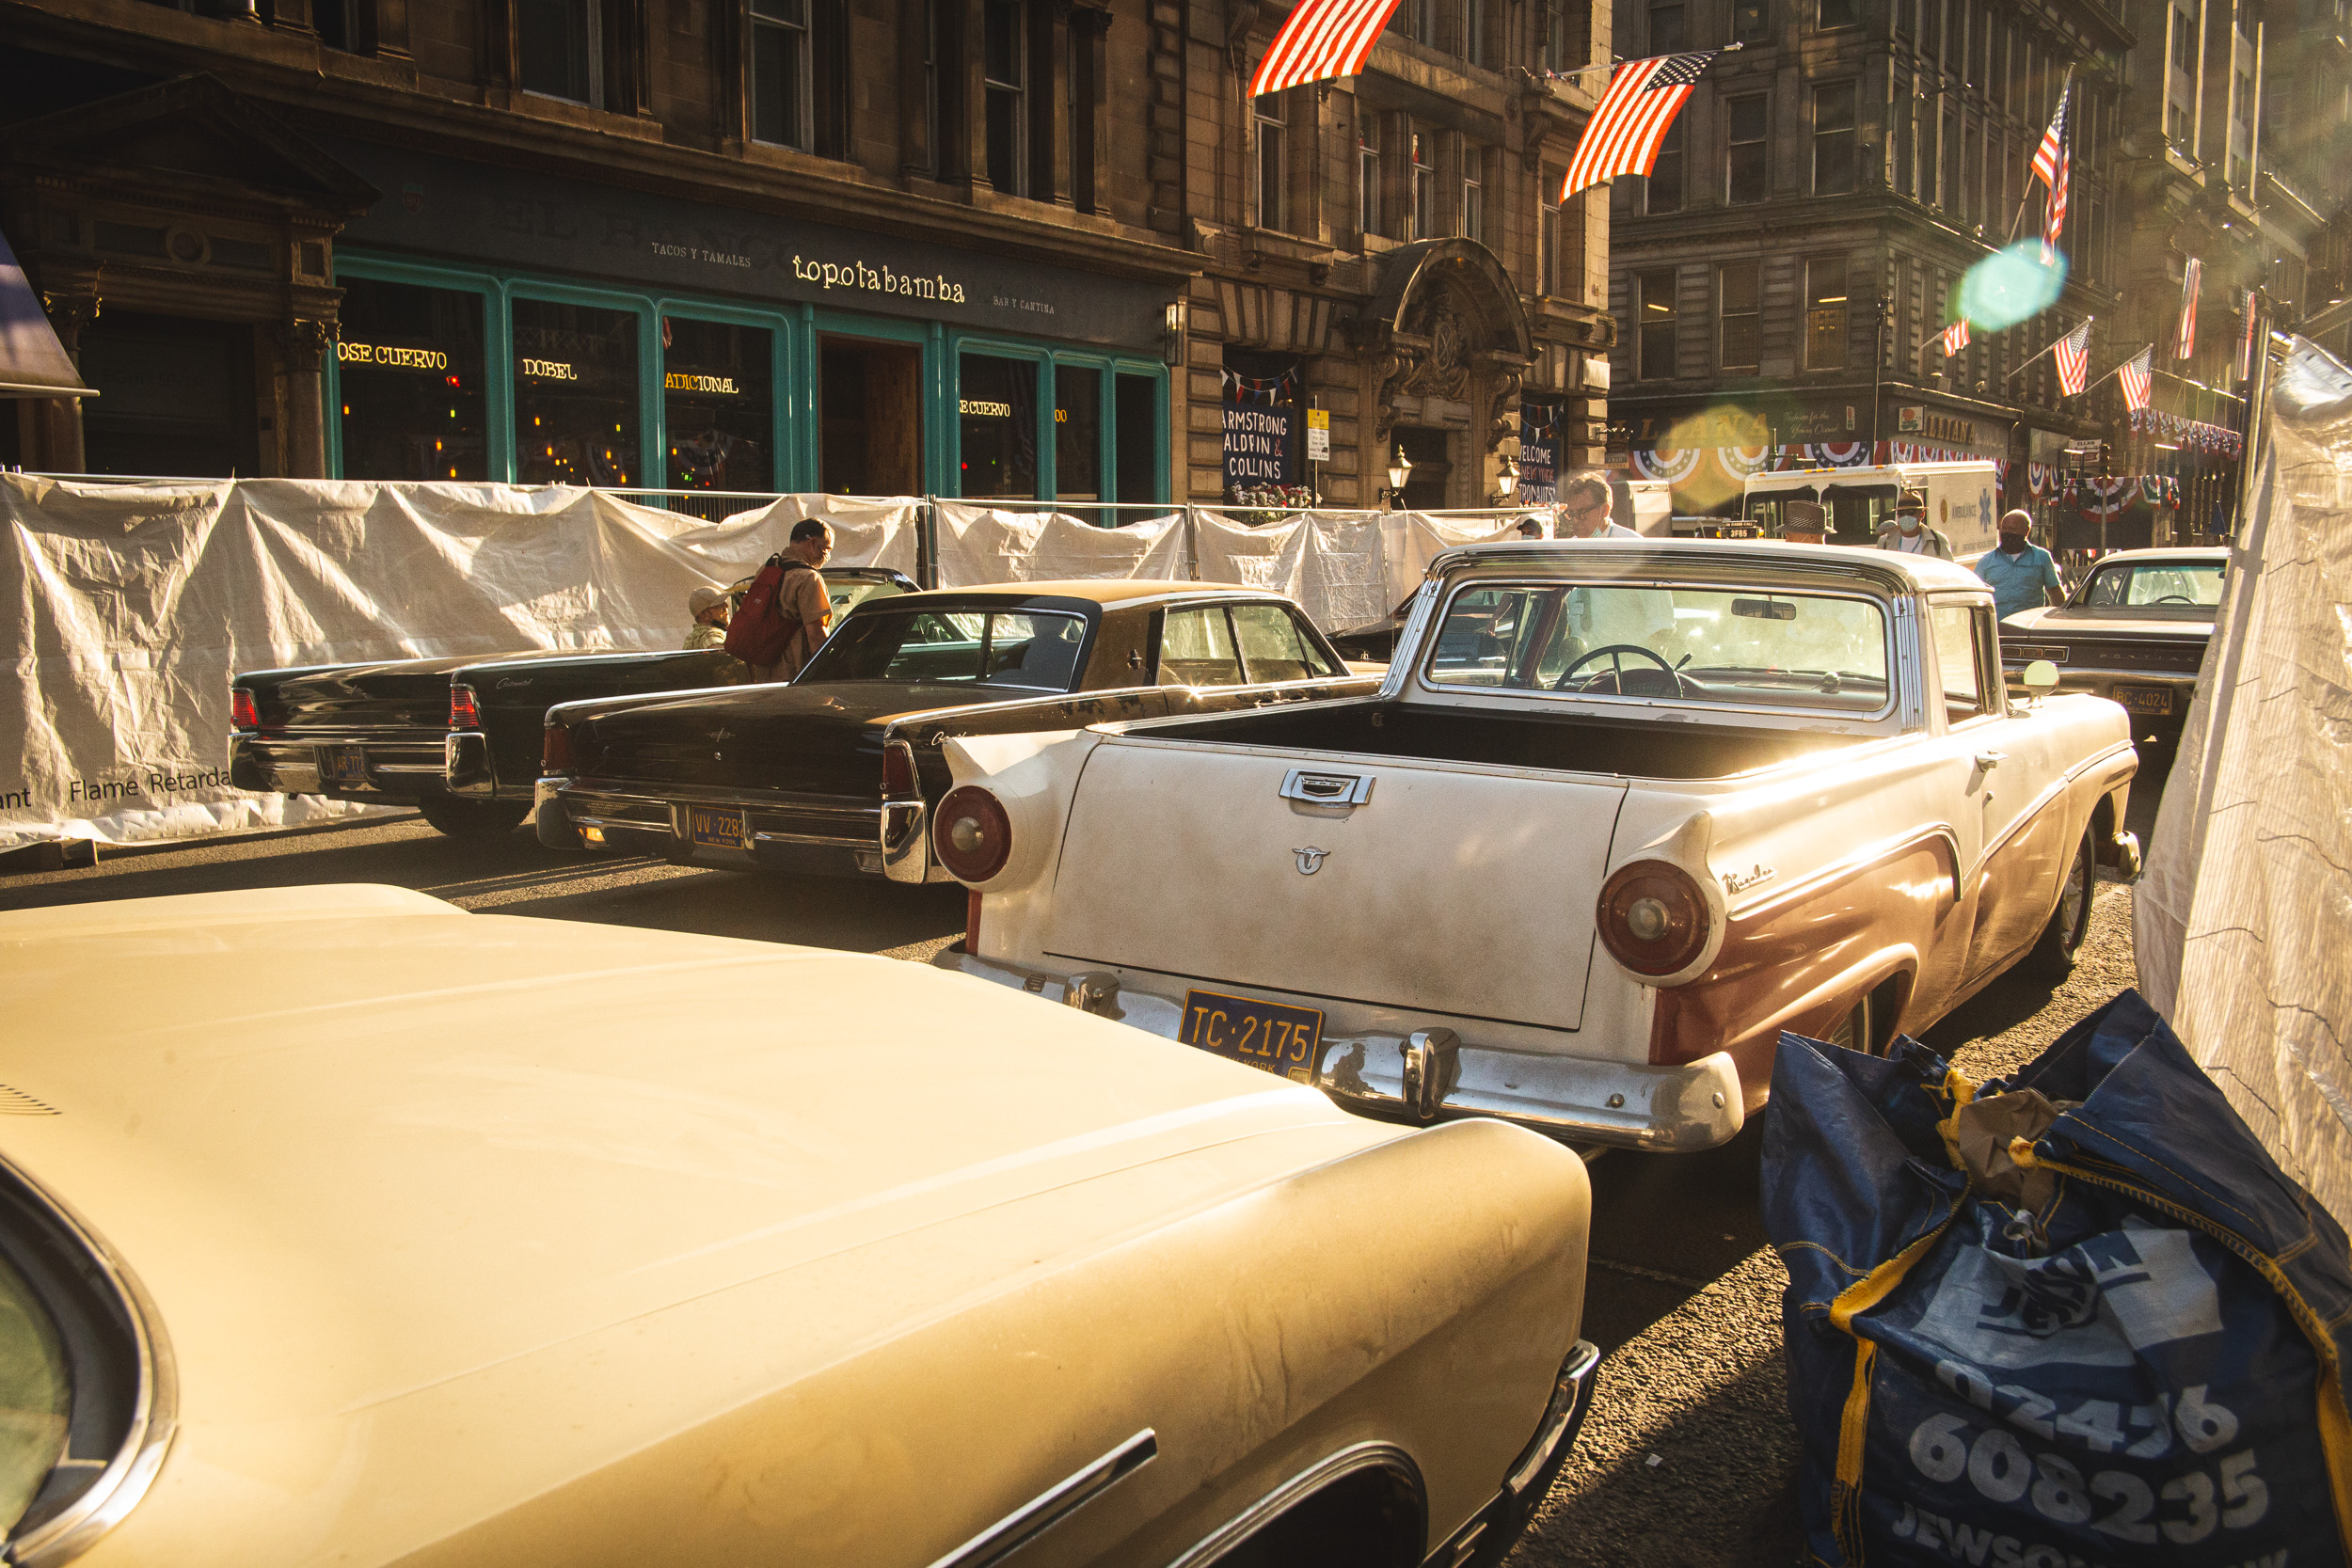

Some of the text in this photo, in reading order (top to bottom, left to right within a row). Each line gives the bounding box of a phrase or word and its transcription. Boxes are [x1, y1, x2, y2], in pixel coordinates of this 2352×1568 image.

[652, 242, 751, 268] TACOS Y TAMALES
[993, 295, 1055, 314] BAR Y CANTINA
[375, 346, 447, 370] CUERVO
[522, 358, 578, 380] DOBEL
[664, 372, 739, 394] ADICIONAL
[969, 401, 1010, 417] CUERVO
[1222, 409, 1287, 436] ARMSTRONG
[1275, 438, 1283, 457] &
[1230, 457, 1281, 480] COLLINS
[1521, 466, 1555, 483] NEW YORK
[70, 779, 139, 802] Flame
[151, 767, 232, 794] Retarda
[1909, 1412, 2269, 1545] 608235
[1891, 1501, 2107, 1568] JEWSO
